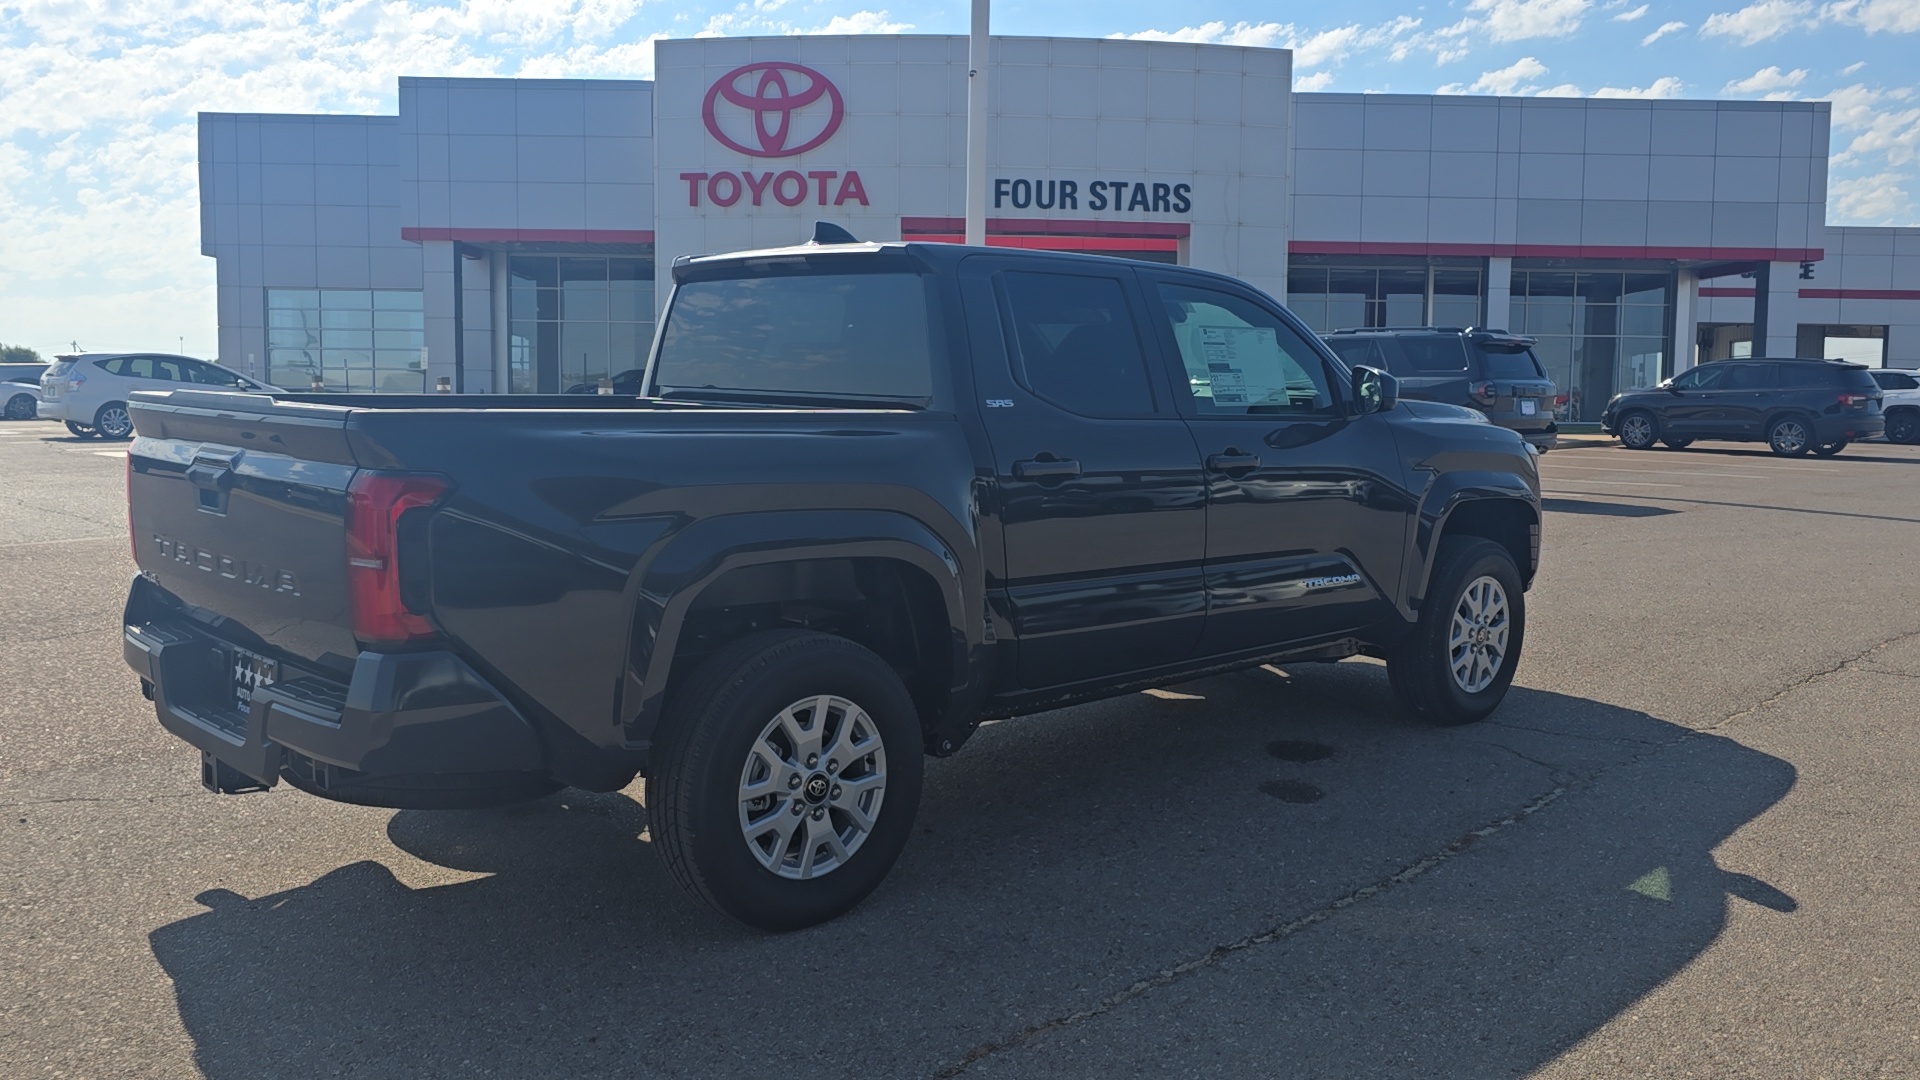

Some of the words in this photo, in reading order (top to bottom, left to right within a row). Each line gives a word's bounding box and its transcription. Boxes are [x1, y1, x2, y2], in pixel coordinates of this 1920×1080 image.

[680, 170, 870, 207] TOYOTA
[994, 178, 1078, 210] FOUR
[1088, 181, 1192, 213] STARS
[153, 533, 301, 597] TACOMA
[1305, 573, 1361, 589] TACOMA
